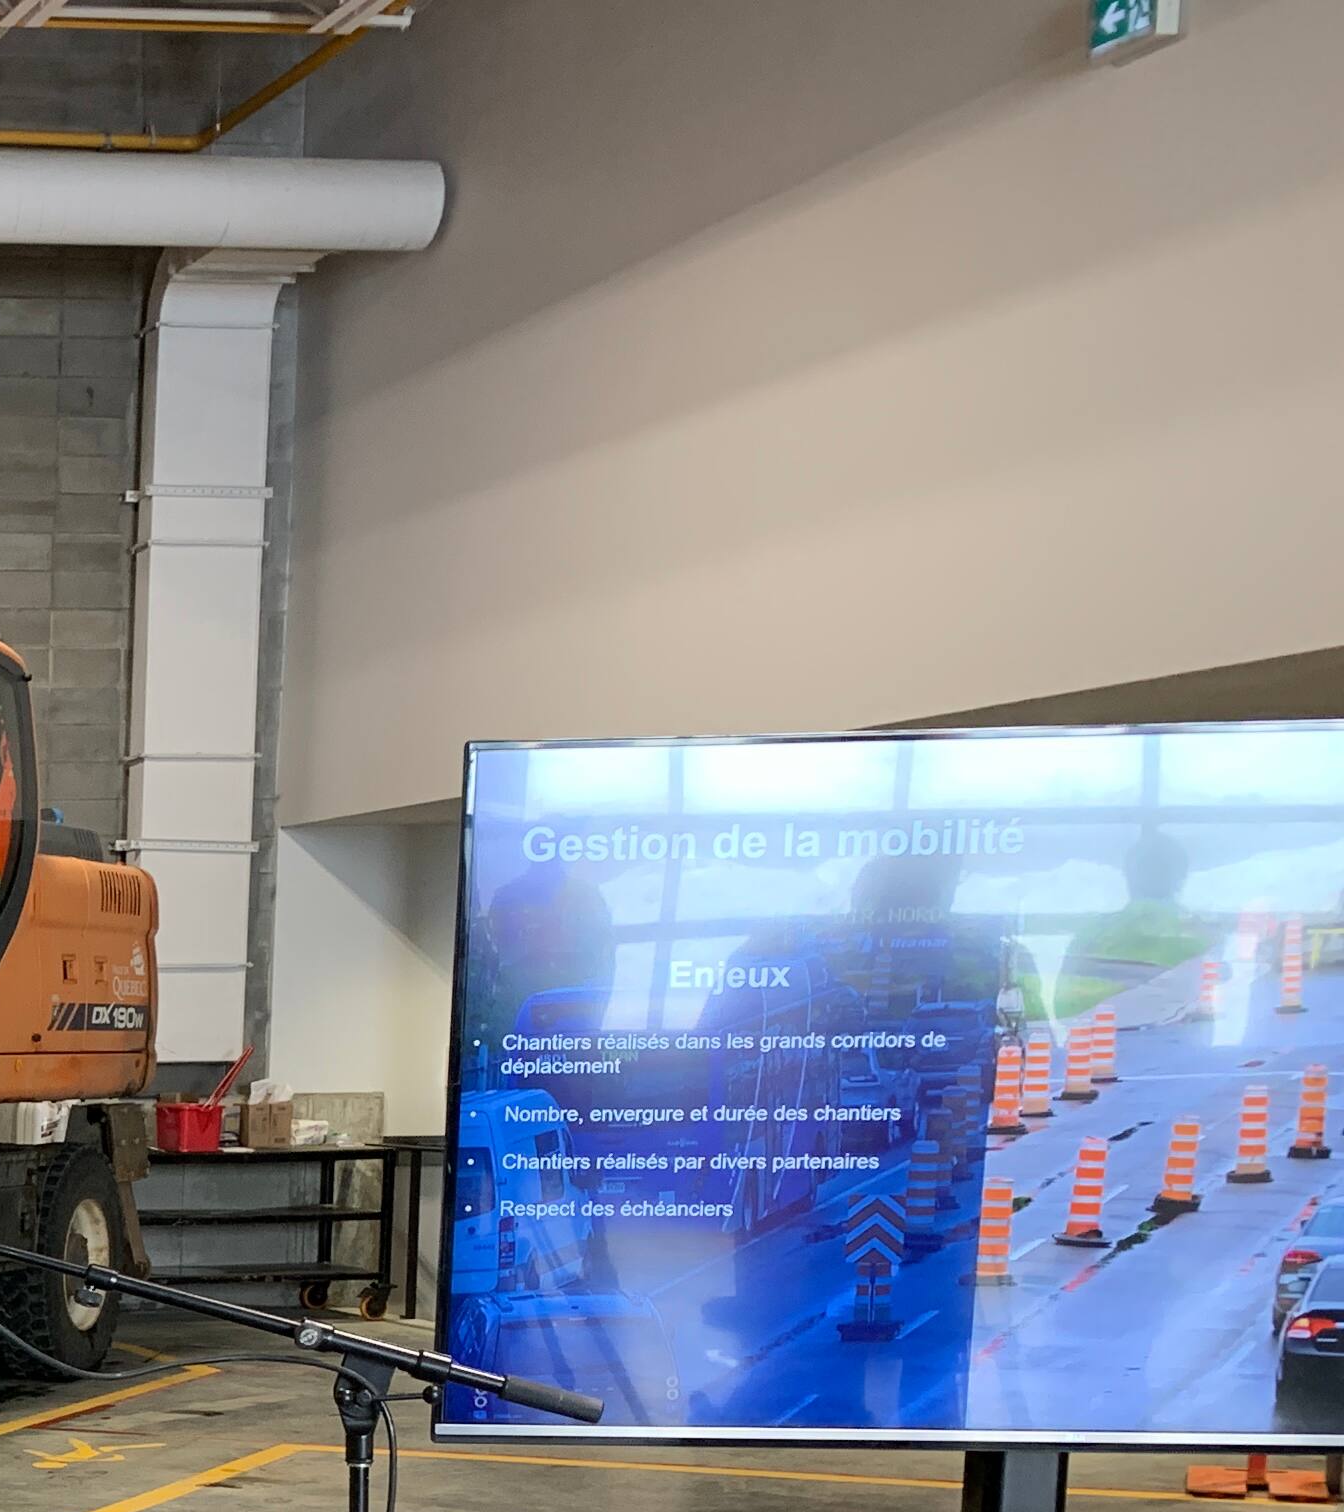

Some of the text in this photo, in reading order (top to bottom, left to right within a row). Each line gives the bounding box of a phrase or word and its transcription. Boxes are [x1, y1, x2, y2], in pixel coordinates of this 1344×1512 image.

[523, 817, 1025, 863] Gestion de la mobilité
[669, 960, 791, 995] Enjeux
[502, 1031, 946, 1052] Chantiers réalisés dans les grands corridors de
[500, 1058, 621, 1078] déplacement
[504, 1105, 902, 1125] Nombre, envergure et durée des chantiers
[502, 1153, 880, 1173] Chantiers réalisés par divers partenaires
[500, 1200, 733, 1221] Respect des échéanciers
